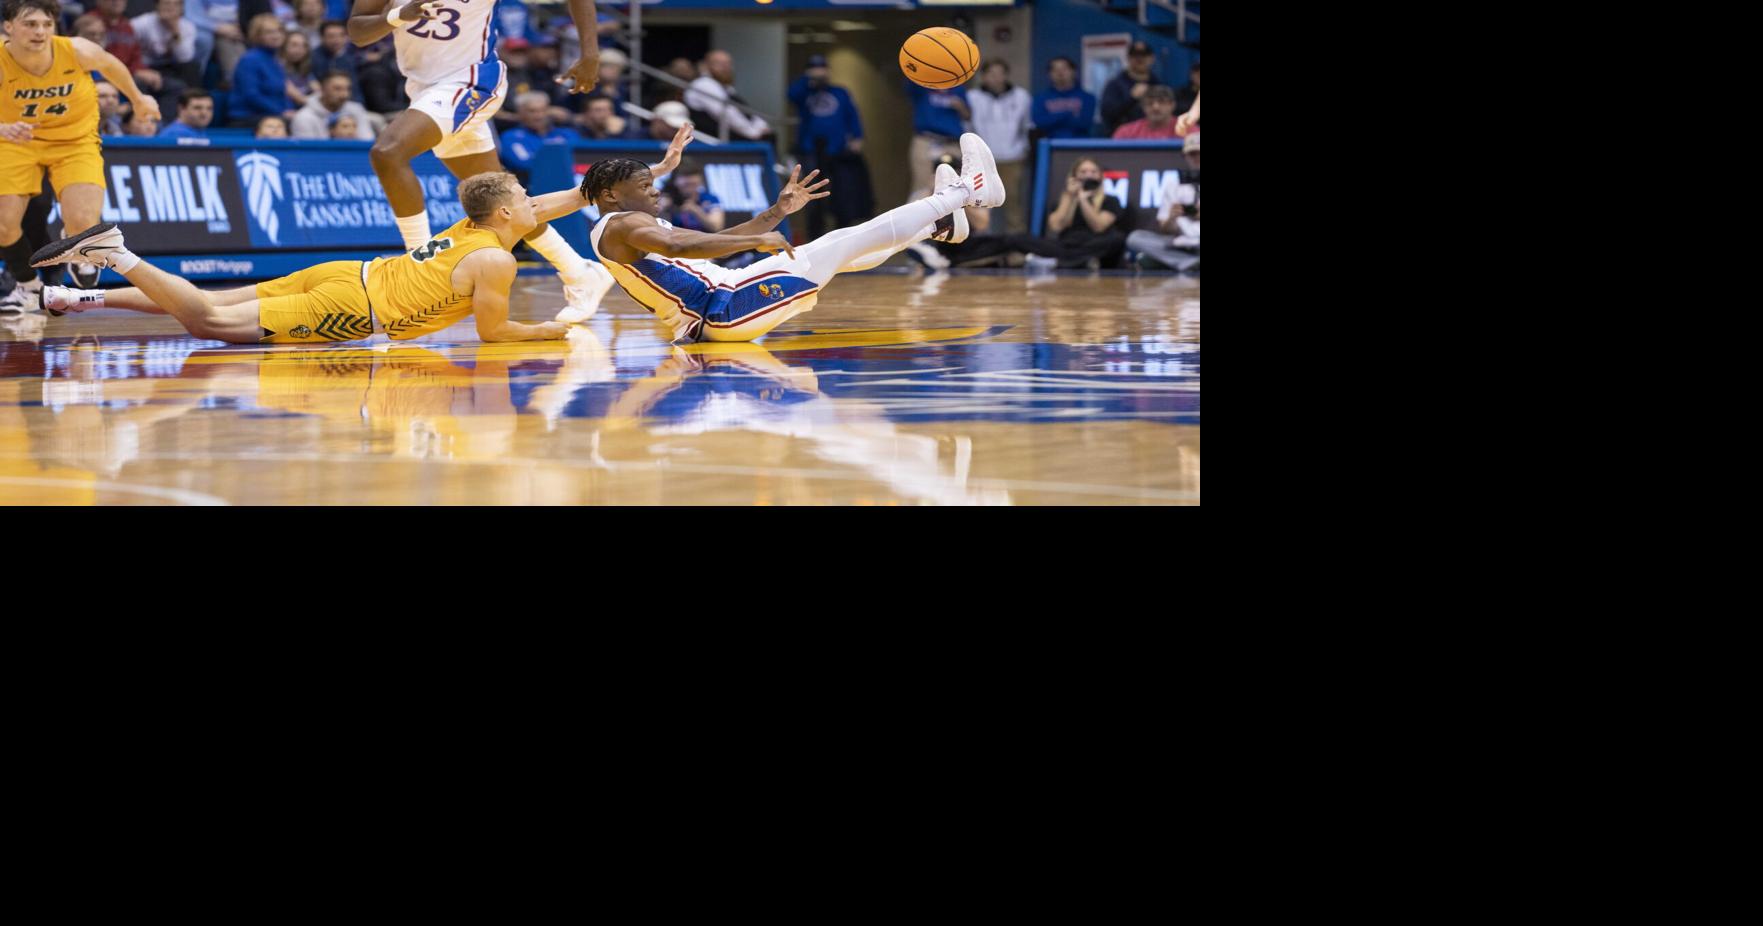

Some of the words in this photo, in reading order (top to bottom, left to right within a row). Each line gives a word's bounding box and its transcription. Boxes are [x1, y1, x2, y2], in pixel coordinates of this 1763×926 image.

[406, 8, 461, 41] 23
[14, 83, 74, 99] NDSU
[21, 103, 68, 117] 14
[138, 165, 229, 222] MILK
[285, 172, 327, 199] THE
[293, 200, 364, 228] KANSAS
